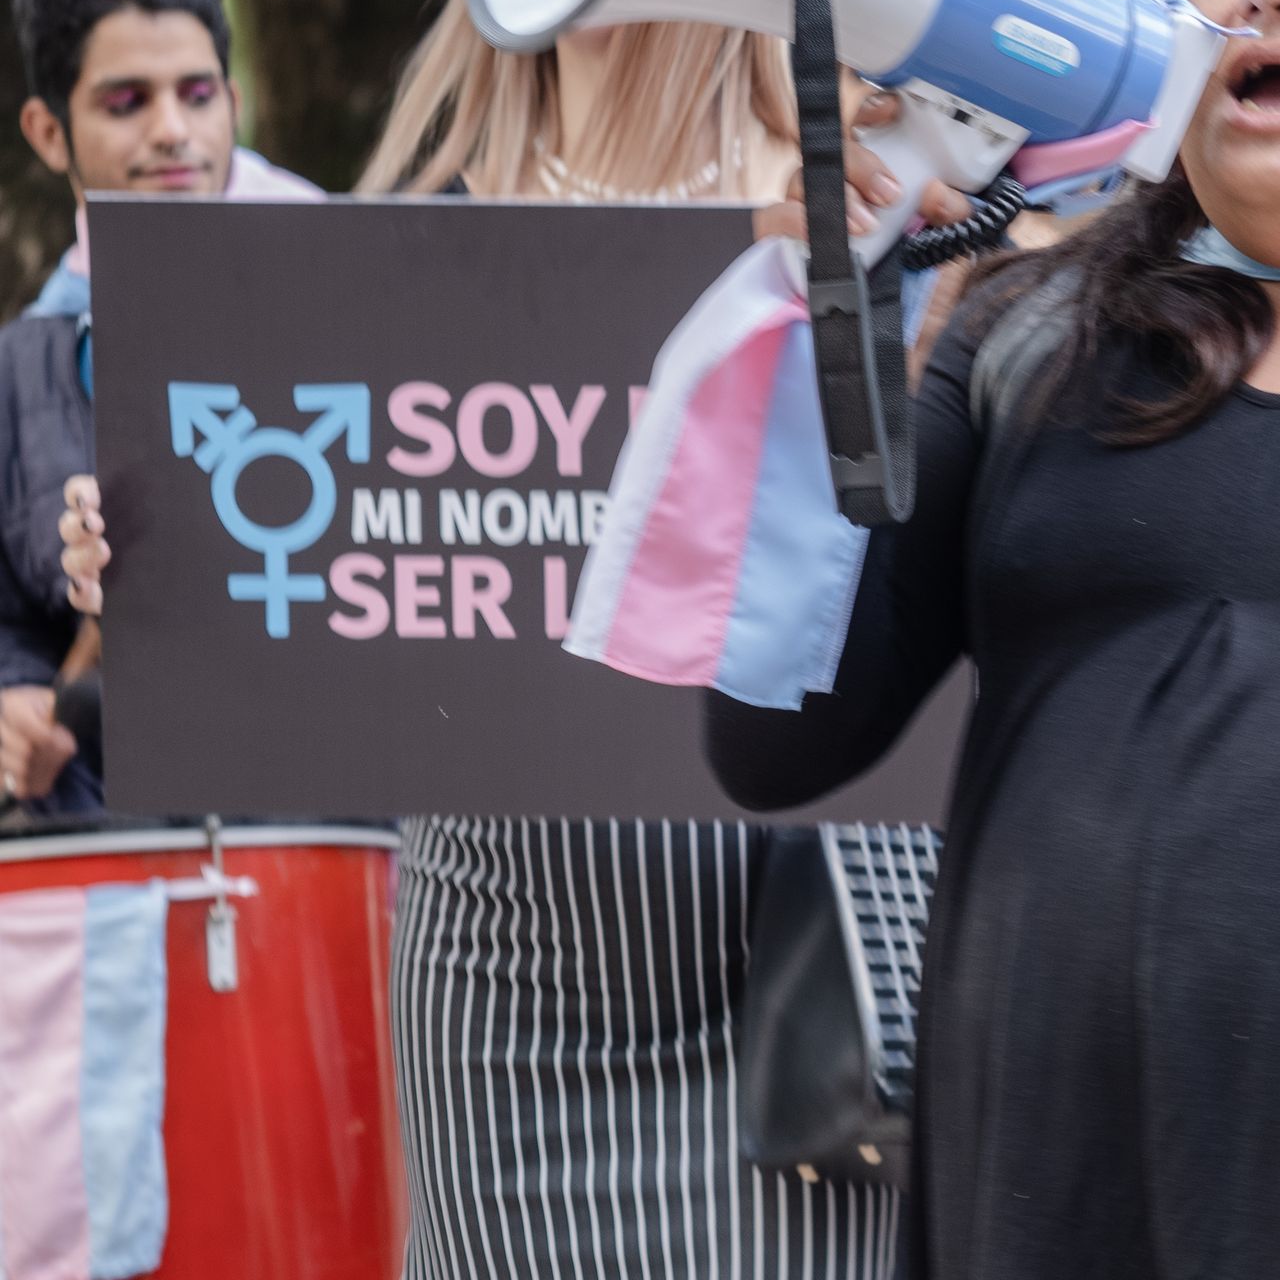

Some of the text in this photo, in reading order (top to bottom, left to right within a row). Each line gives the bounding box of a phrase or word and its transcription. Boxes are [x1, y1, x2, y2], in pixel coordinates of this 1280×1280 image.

[387, 381, 607, 478] SOY
[351, 488, 612, 547] MI NOMB
[327, 552, 517, 640] SER
